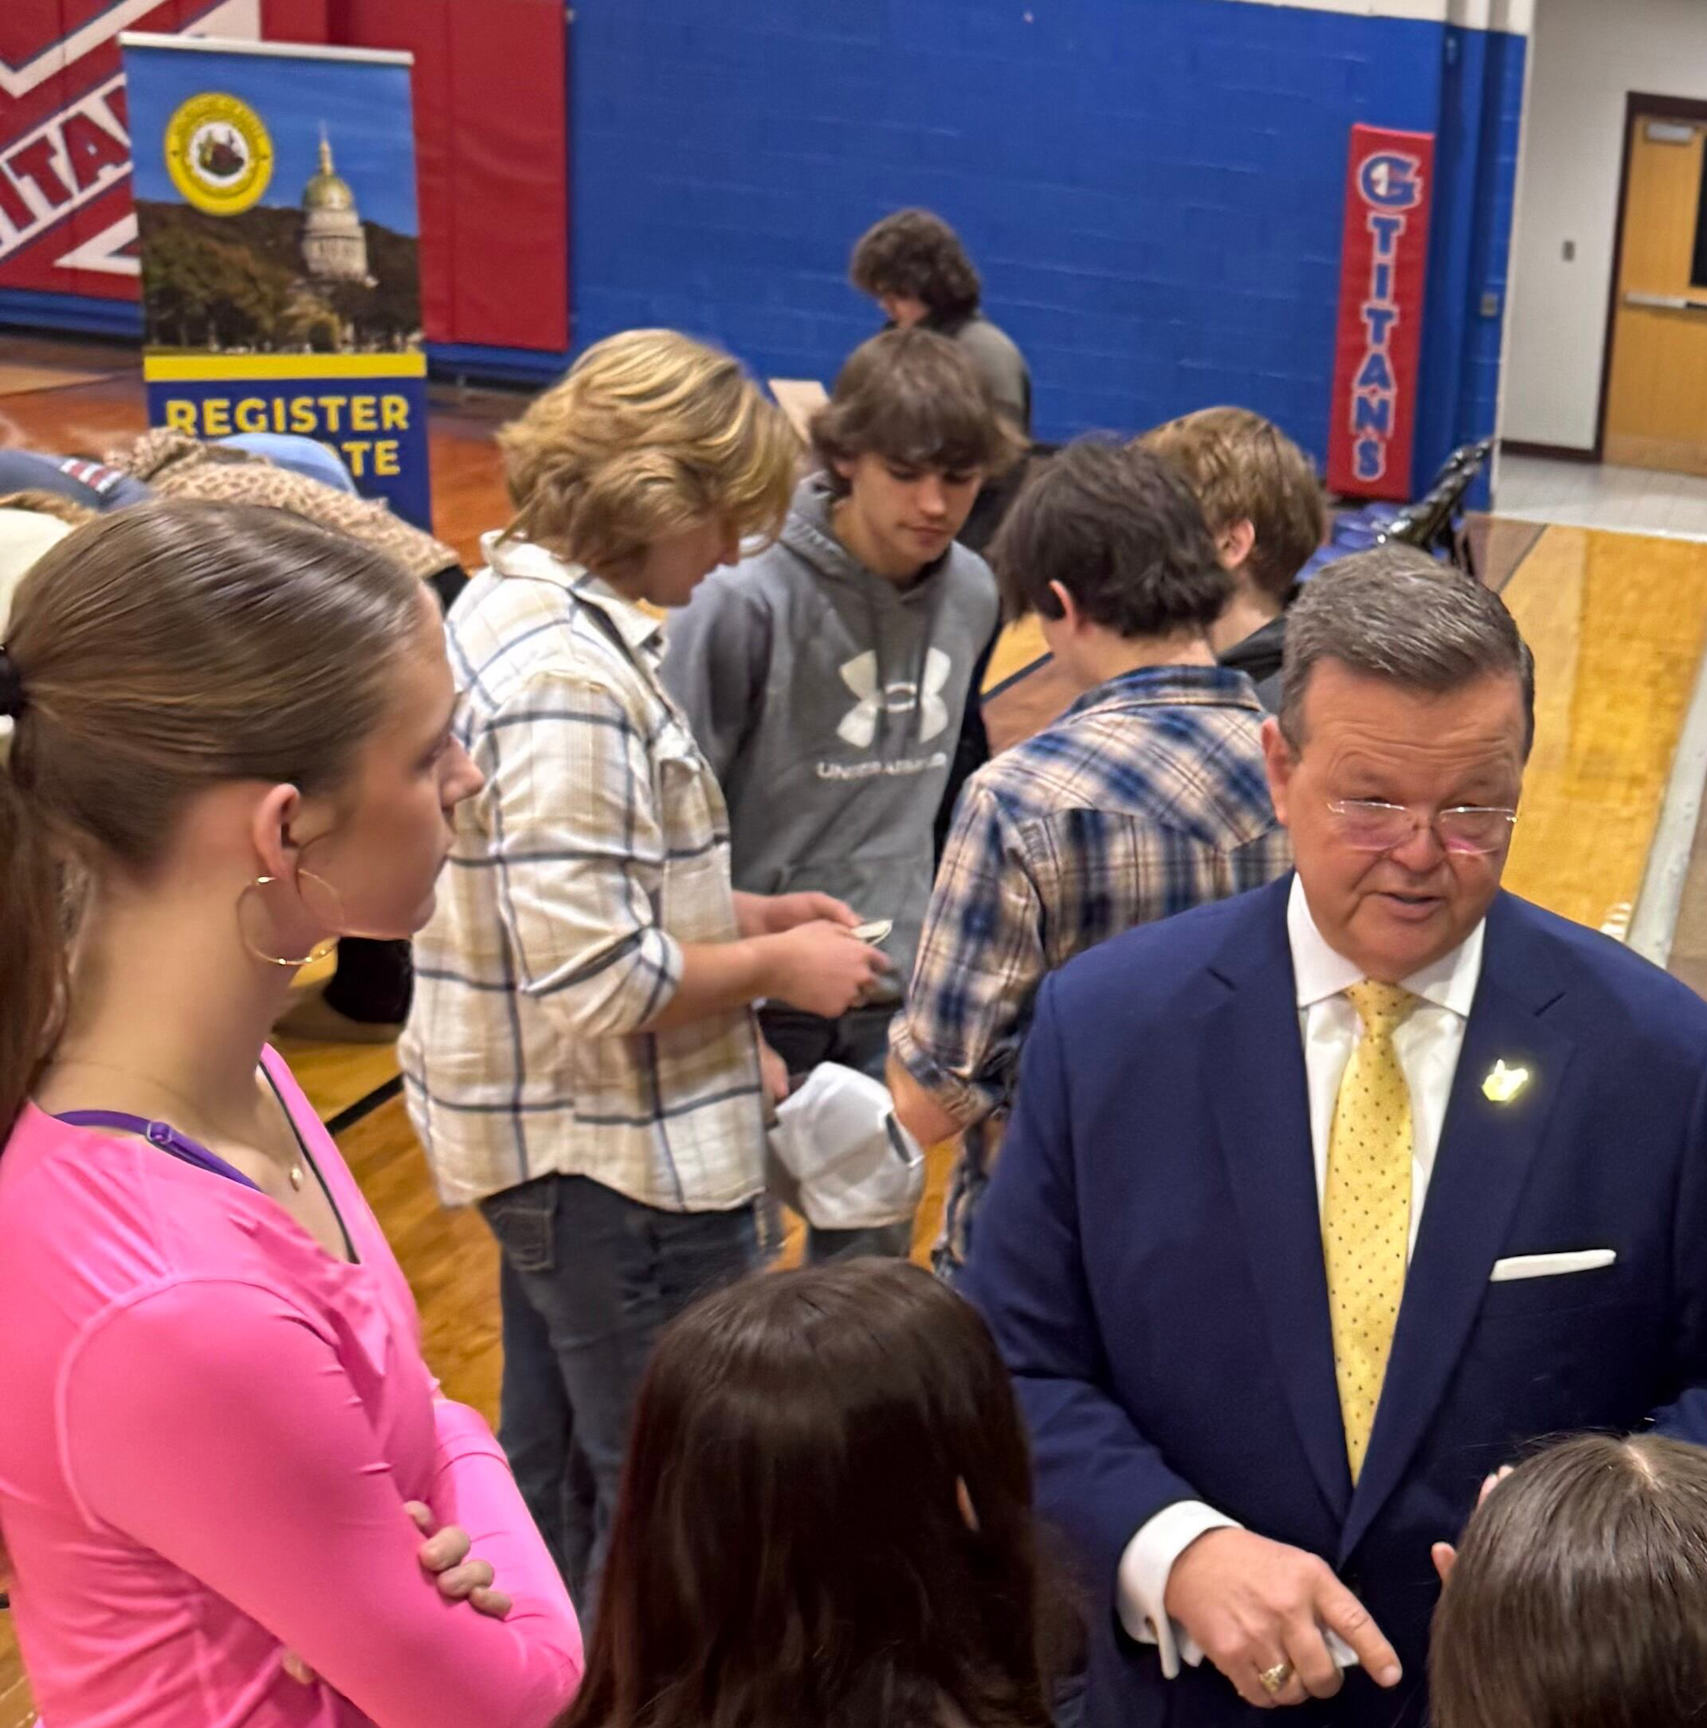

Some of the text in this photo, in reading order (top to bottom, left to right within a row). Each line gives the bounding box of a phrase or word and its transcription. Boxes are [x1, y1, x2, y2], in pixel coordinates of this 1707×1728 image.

[0, 85, 131, 233] ITA
[1350, 211, 1407, 483] TITANS
[165, 395, 410, 436] REGISTER
[324, 440, 401, 477] TE
